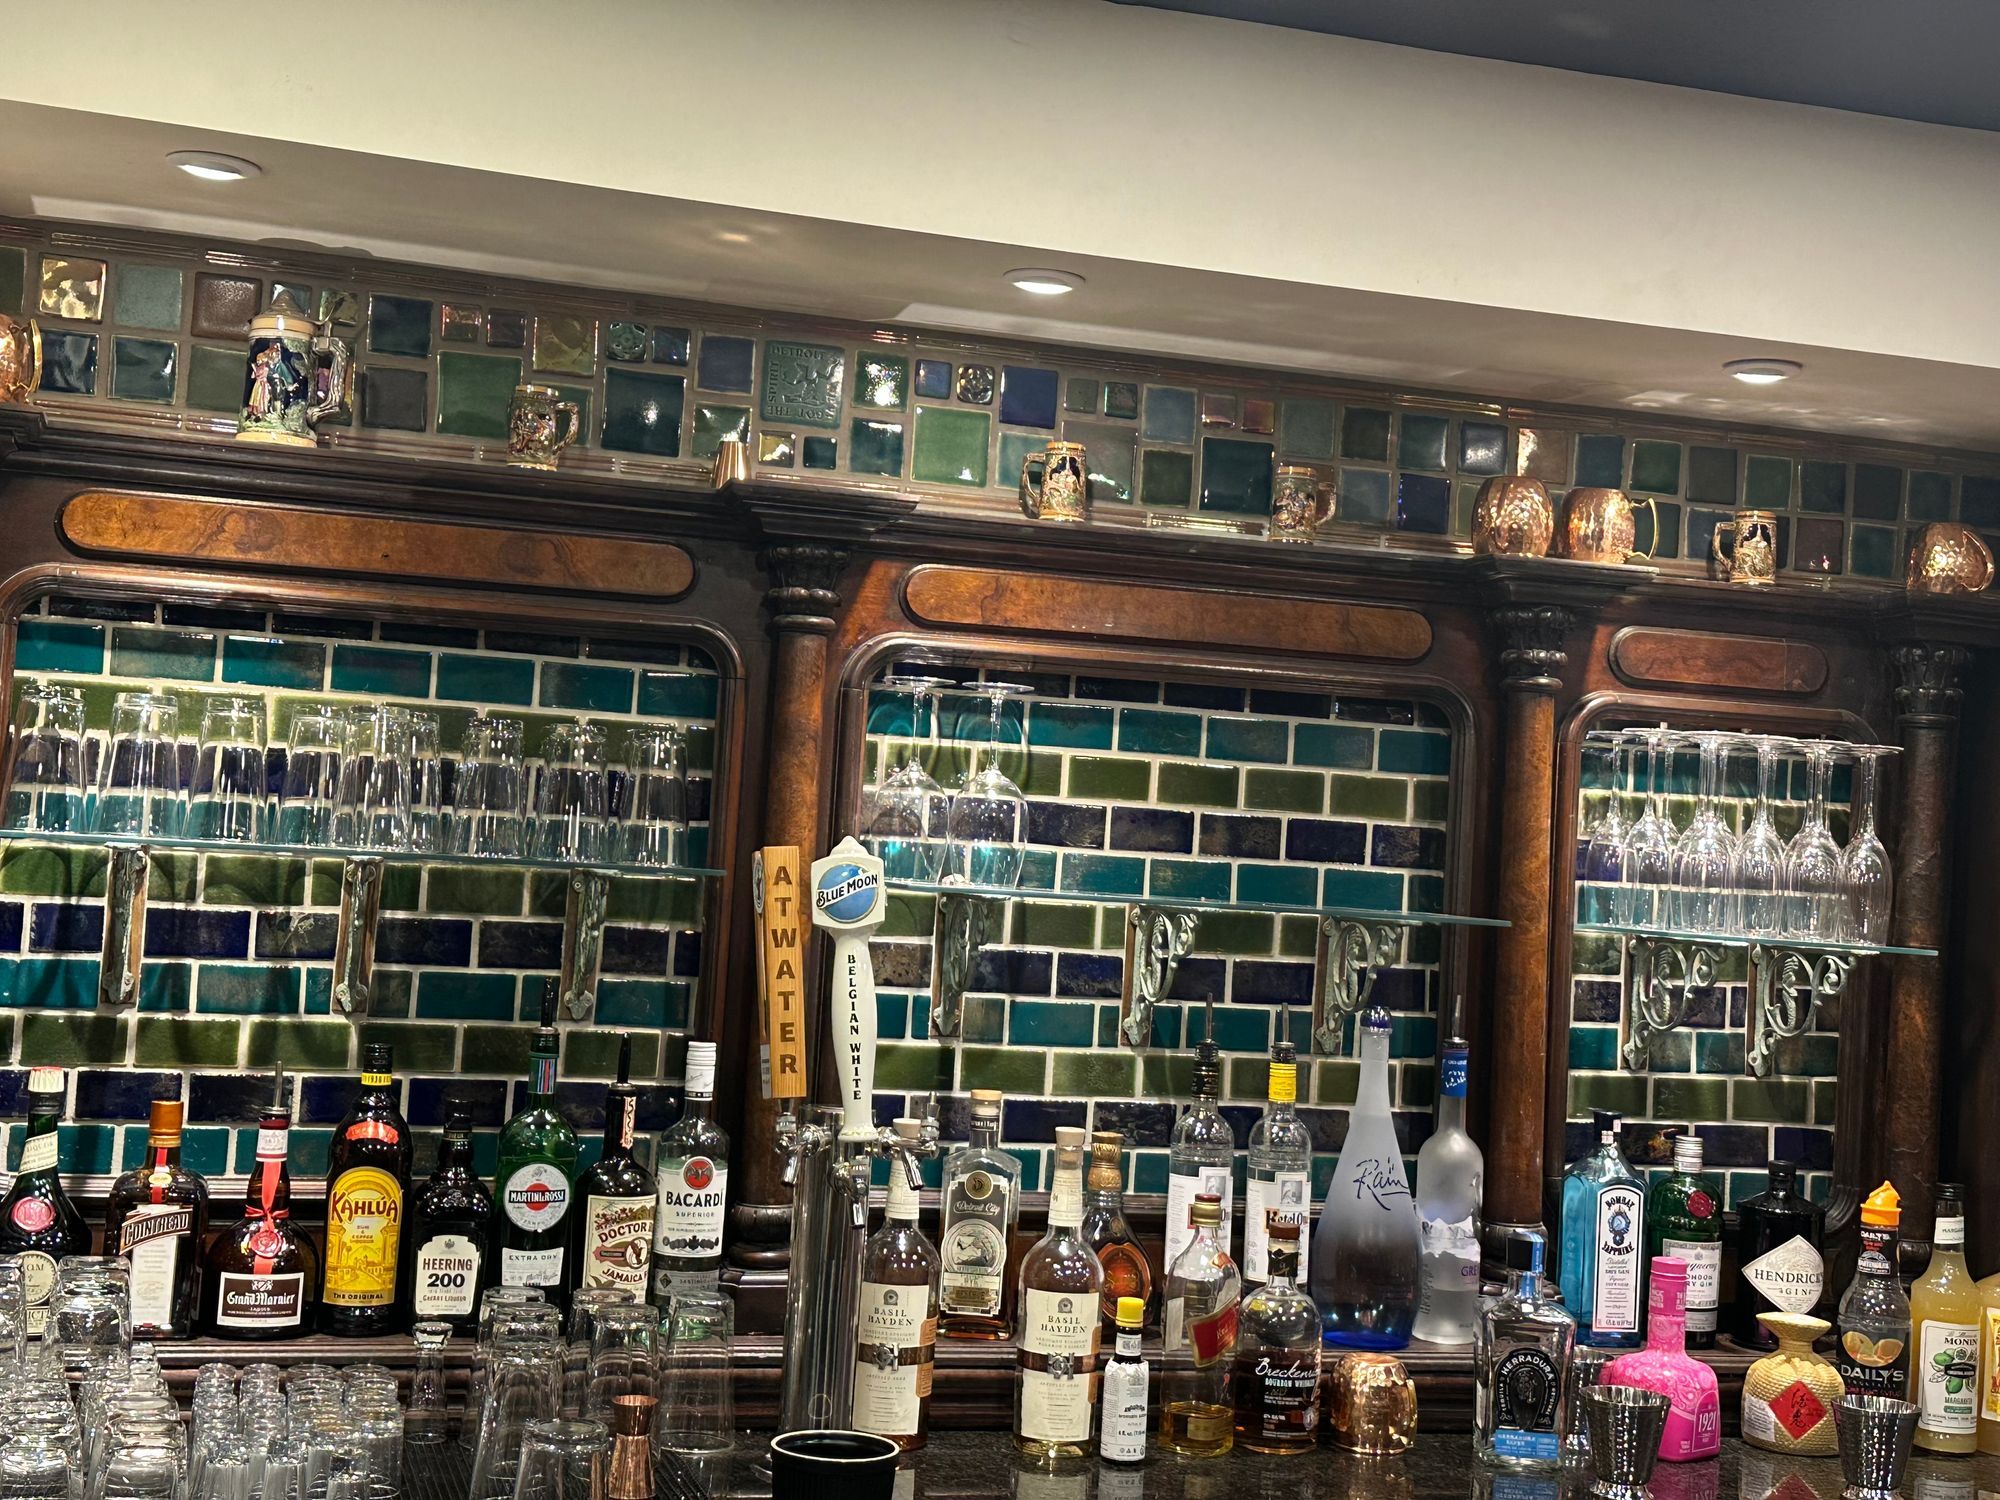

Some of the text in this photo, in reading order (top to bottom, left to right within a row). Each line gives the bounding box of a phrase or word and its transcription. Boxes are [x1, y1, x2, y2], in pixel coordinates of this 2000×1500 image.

[769, 345, 826, 360] DETROIT
[768, 361, 779, 403] SPIRIT
[767, 405, 790, 417] THE
[816, 874, 878, 908] BLUE MOON
[771, 865, 799, 1075] ATWATER
[847, 954, 862, 1101] BELGIAN WHITE
[509, 1191, 543, 1203] MARTINI
[545, 1190, 565, 1202] ROSSI
[1605, 1196, 1636, 1211] BOMBAY
[331, 1190, 399, 1224] KAHLÚA
[676, 1210, 715, 1218] SUPERIOR
[125, 1212, 190, 1247] COINTREAU
[598, 1221, 647, 1243] DOCTOR
[1601, 1240, 1635, 1256] SAPPHIRE
[422, 1258, 473, 1271] HEERING
[1460, 1265, 1478, 1277] GRE
[427, 1272, 466, 1288] 200
[601, 1268, 644, 1283] JAMAICA
[226, 1291, 296, 1306] Grand Marnier
[1785, 1287, 1808, 1296] GIN
[873, 1306, 908, 1318] BASIL
[867, 1314, 914, 1327] HAYDEN
[1047, 1315, 1081, 1326] BASIL
[1041, 1323, 1086, 1334] HAYDEN
[1944, 1337, 1978, 1346] MONIN
[1500, 1354, 1555, 1381] HERRADURA
[1840, 1364, 1905, 1385] DAILY'S
[1698, 1411, 1717, 1433] 1921
